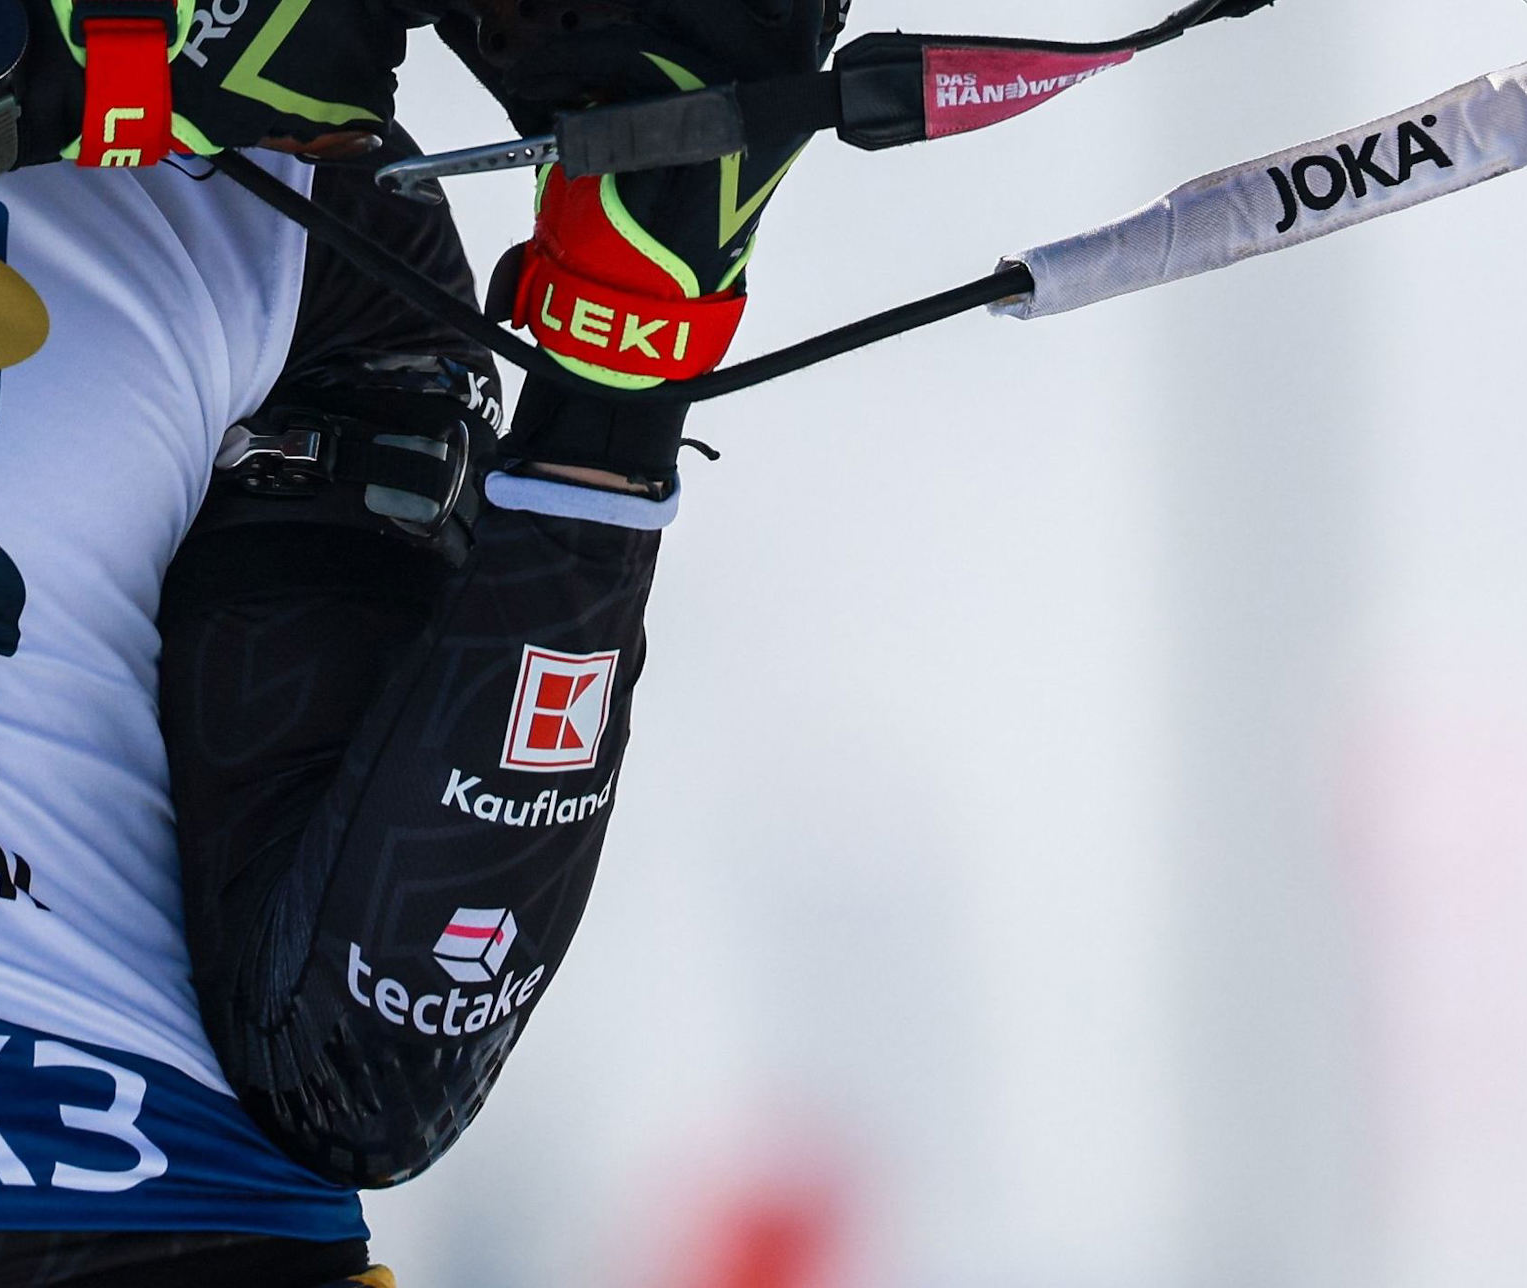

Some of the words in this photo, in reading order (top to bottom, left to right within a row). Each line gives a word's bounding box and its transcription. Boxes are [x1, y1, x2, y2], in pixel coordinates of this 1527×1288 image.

[936, 73, 977, 87] DAS
[541, 282, 690, 361] LEKI
[440, 768, 616, 827] Kaufland
[347, 941, 544, 1039] tectake
